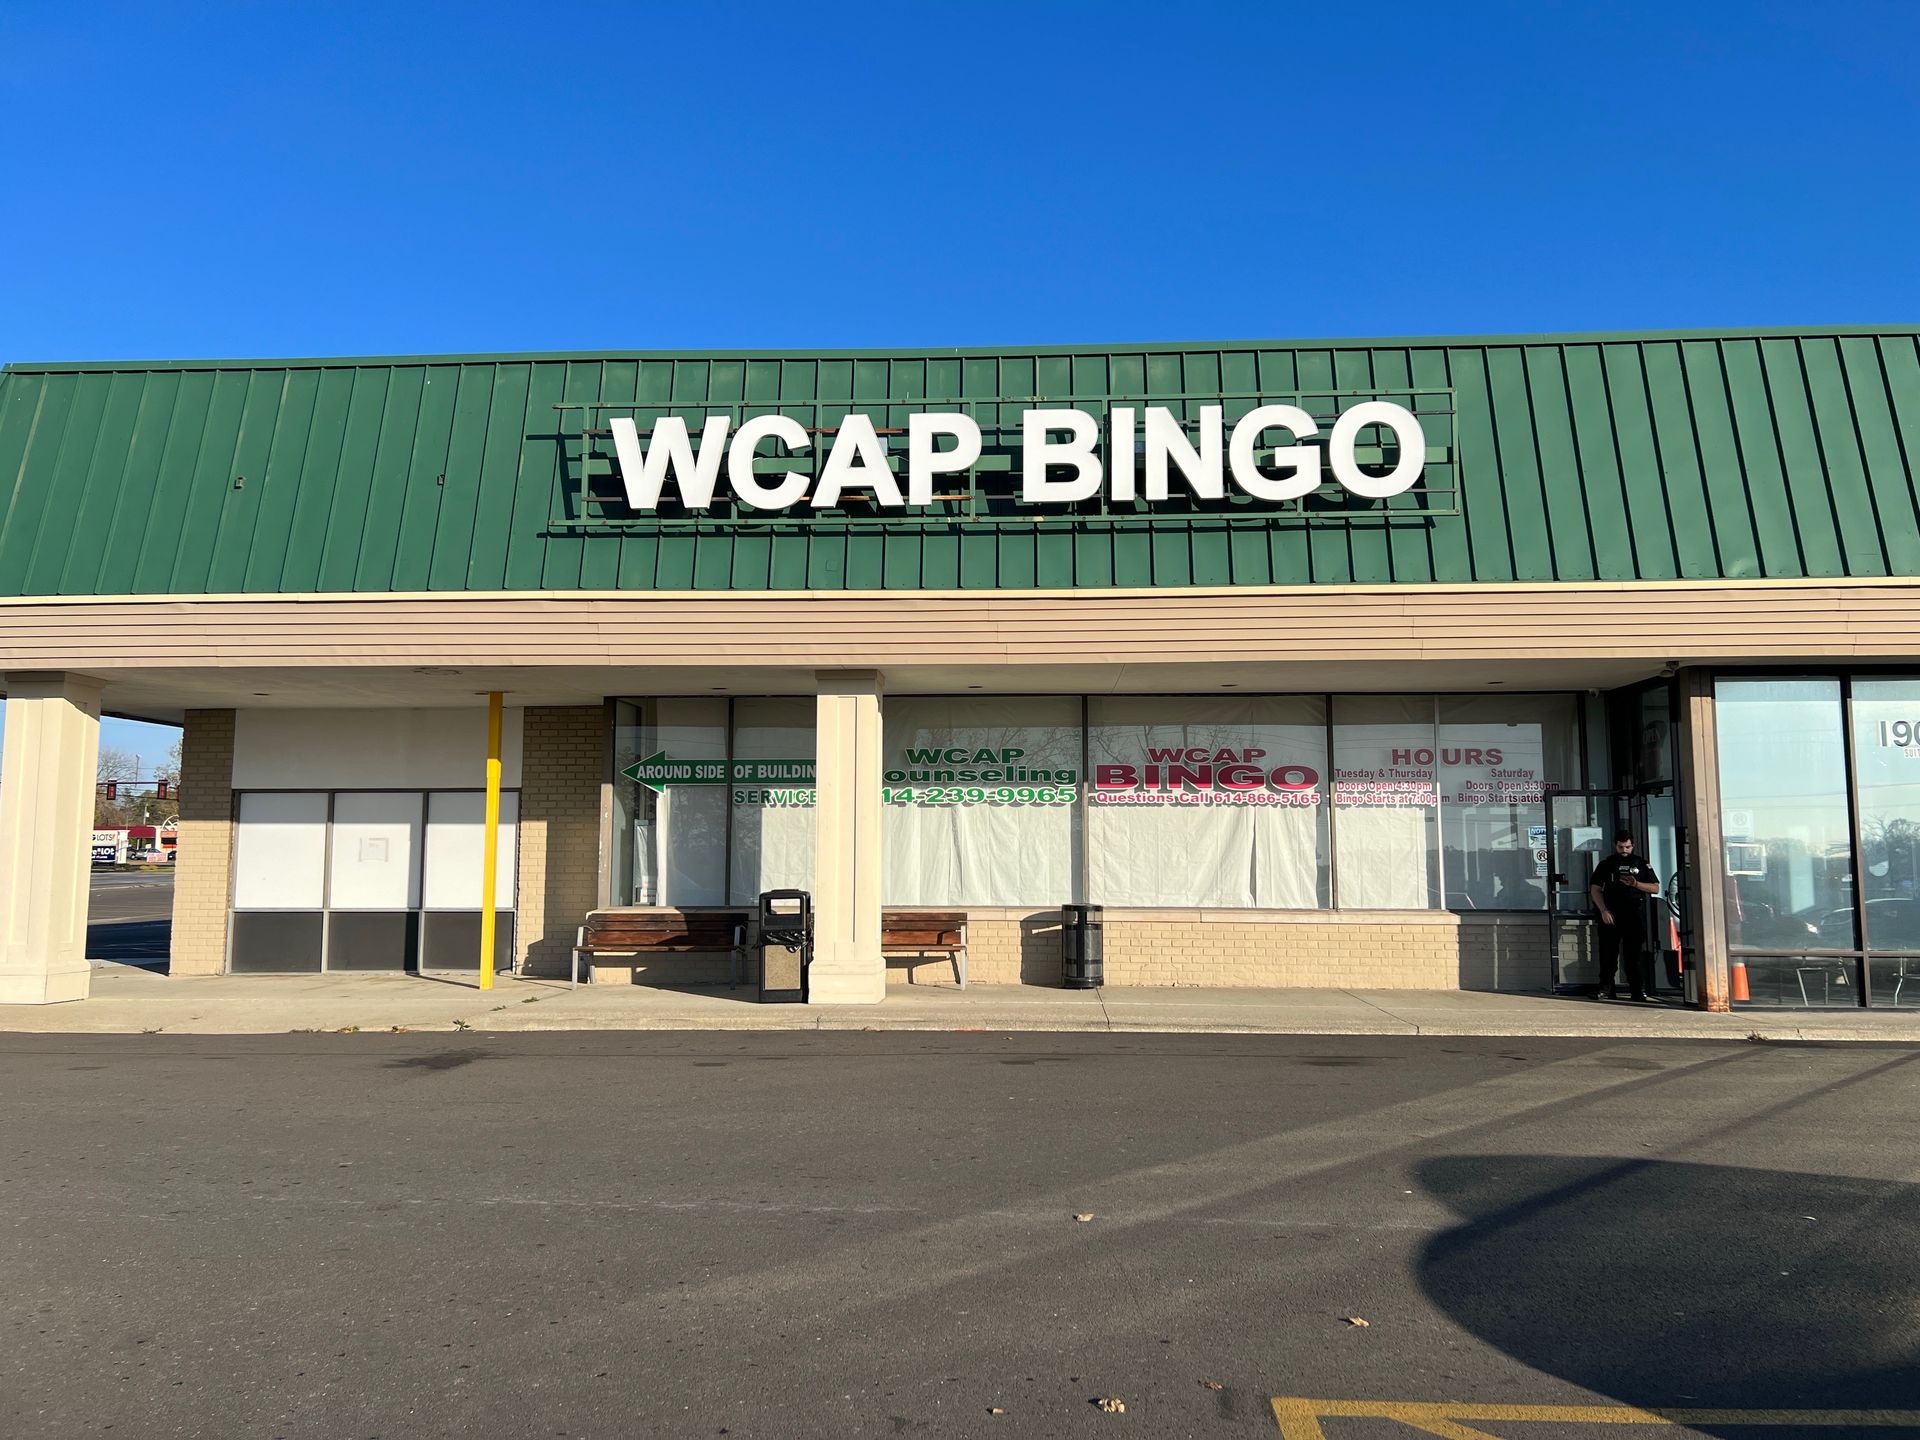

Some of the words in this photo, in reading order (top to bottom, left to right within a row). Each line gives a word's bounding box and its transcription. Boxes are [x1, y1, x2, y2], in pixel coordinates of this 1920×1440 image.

[609, 412, 982, 510] WCAP
[1021, 400, 1427, 504] BINGO
[905, 747, 1025, 765] WCAP
[1147, 747, 1267, 764] WCAP
[1391, 748, 1504, 766] HOURS
[636, 764, 692, 779] AROUND
[694, 764, 725, 779] SIDE
[733, 764, 754, 779] OF
[757, 764, 816, 779] BUILDIN
[883, 765, 1077, 785] ounseling
[1095, 764, 1320, 791] BINGO
[1334, 768, 1375, 780] Tuesday
[1378, 768, 1385, 778] &
[1388, 768, 1433, 780] Thursday
[1491, 768, 1535, 780] Saturday
[1337, 781, 1367, 791] Doors
[1368, 781, 1393, 792] Open
[1395, 781, 1432, 792] 4:30pm
[1466, 780, 1494, 790] Doors
[1497, 780, 1522, 792] Open
[1524, 780, 1560, 791] 3:30pm
[882, 786, 1077, 804] 14-239-9965
[1096, 792, 1174, 804] Questions
[1178, 792, 1209, 803] Call
[1213, 792, 1320, 805] 614-866-5165
[1335, 793, 1364, 805] Bingo
[1365, 793, 1396, 804] Starts
[1399, 793, 1409, 804] at
[1457, 792, 1486, 805] Bingo
[1488, 792, 1518, 804] Starts
[1520, 792, 1531, 803] at
